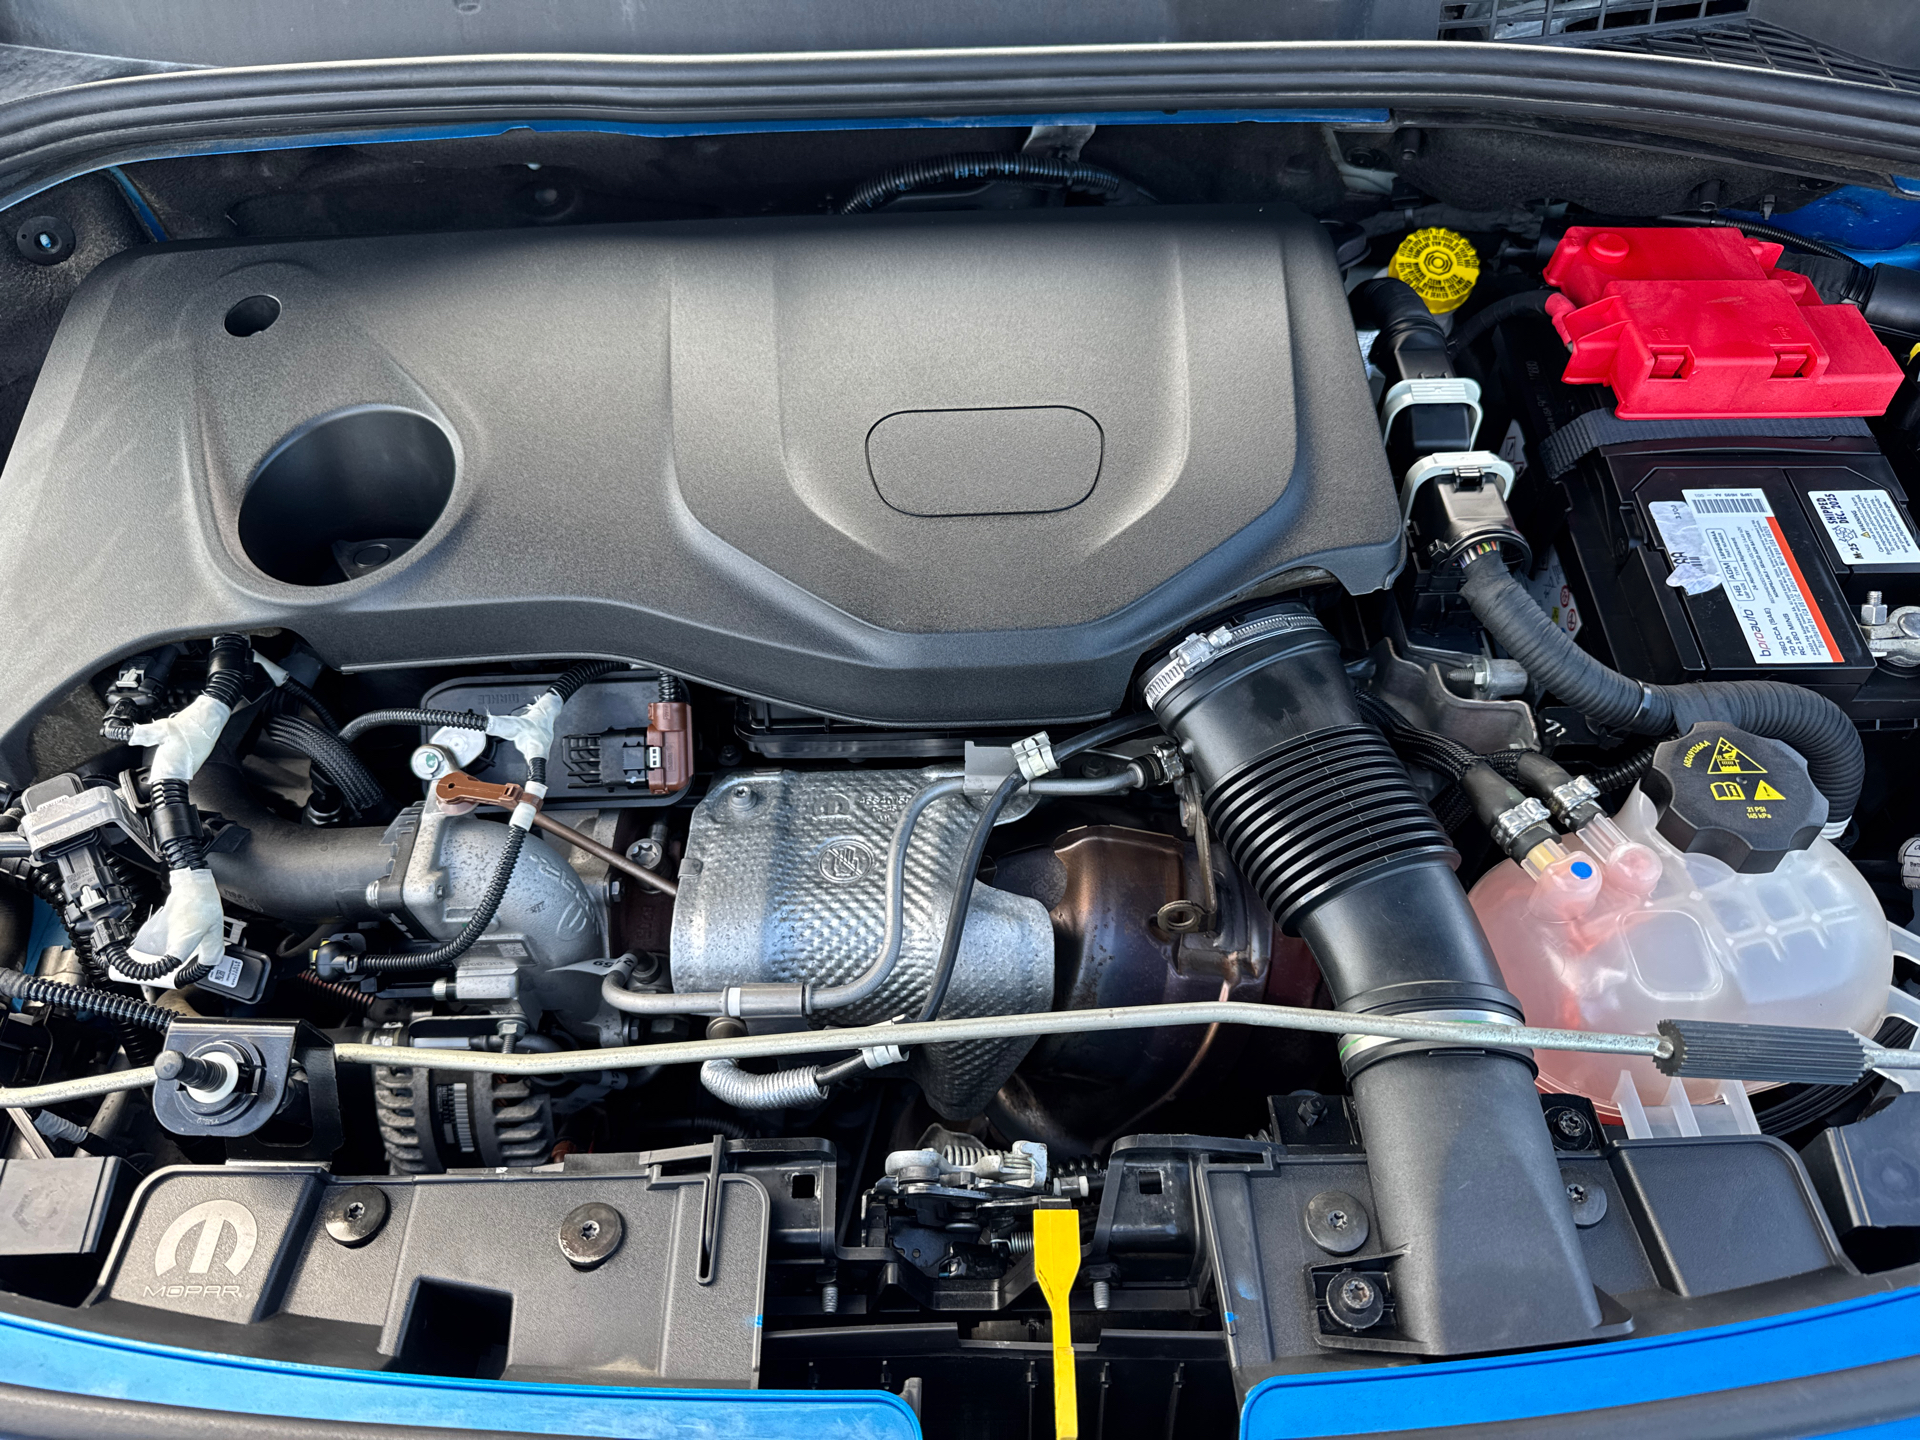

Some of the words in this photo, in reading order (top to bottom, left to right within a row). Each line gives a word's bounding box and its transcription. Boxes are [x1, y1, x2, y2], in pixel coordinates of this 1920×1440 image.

[1824, 493, 1842, 509] 2025
[1816, 497, 1838, 524] SHIPPED
[1834, 511, 1849, 523] DEC.
[1847, 543, 1864, 559] M-25
[1722, 562, 1736, 579] AGM
[1732, 585, 1743, 596] H6
[1762, 607, 1777, 625] (SAE)
[1782, 613, 1795, 630] MINS
[1742, 608, 1772, 656] bproauto
[1771, 626, 1783, 639] CCA
[1784, 635, 1793, 644] Ah
[1788, 645, 1798, 655] 70
[1797, 646, 1806, 655] RC
[142, 1284, 240, 1298] MOPAR
